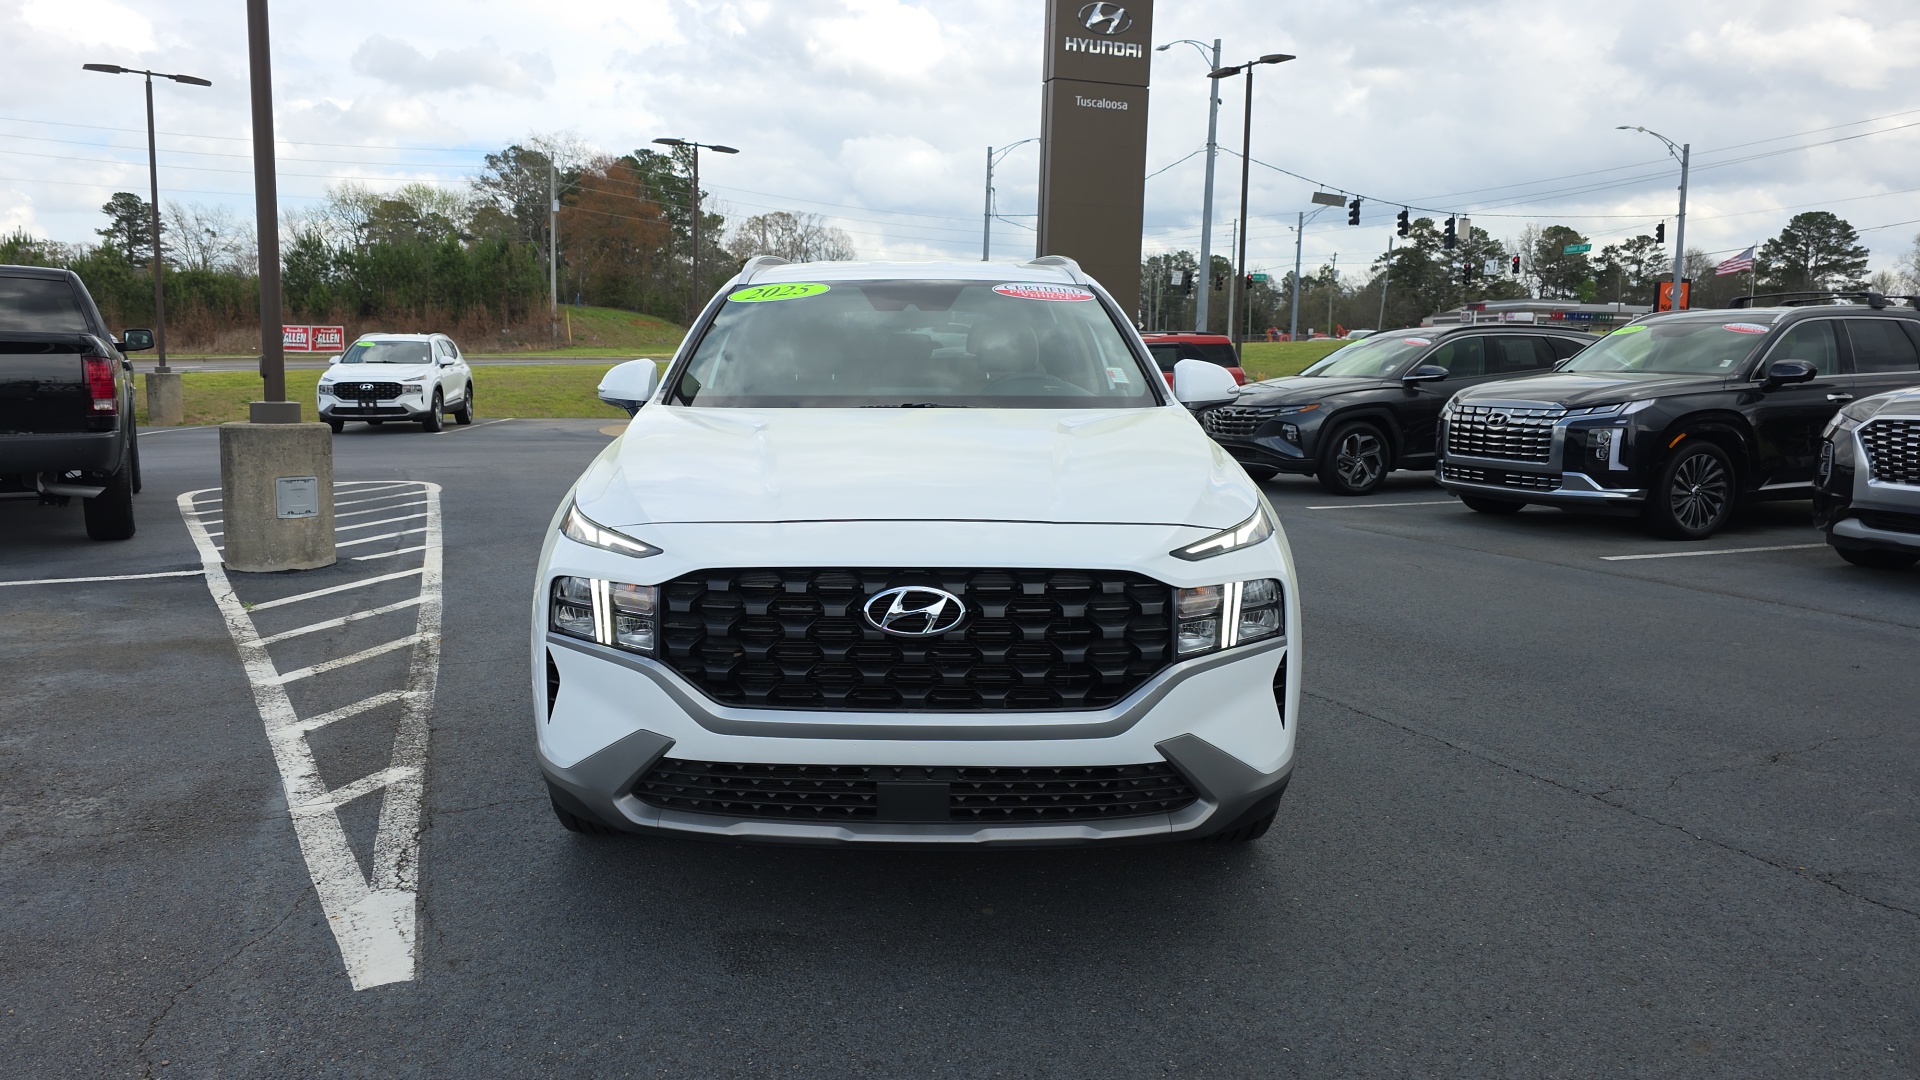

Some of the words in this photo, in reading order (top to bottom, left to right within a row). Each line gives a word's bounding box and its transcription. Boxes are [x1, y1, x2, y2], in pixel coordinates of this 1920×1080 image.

[1065, 36, 1142, 58] HYUNDAI
[1075, 95, 1128, 111] Tuscaloosa
[745, 284, 814, 299] 2025
[1004, 285, 1082, 294] CERTIFIED
[283, 333, 306, 343] ALLEN
[317, 333, 340, 344] ALLEN
